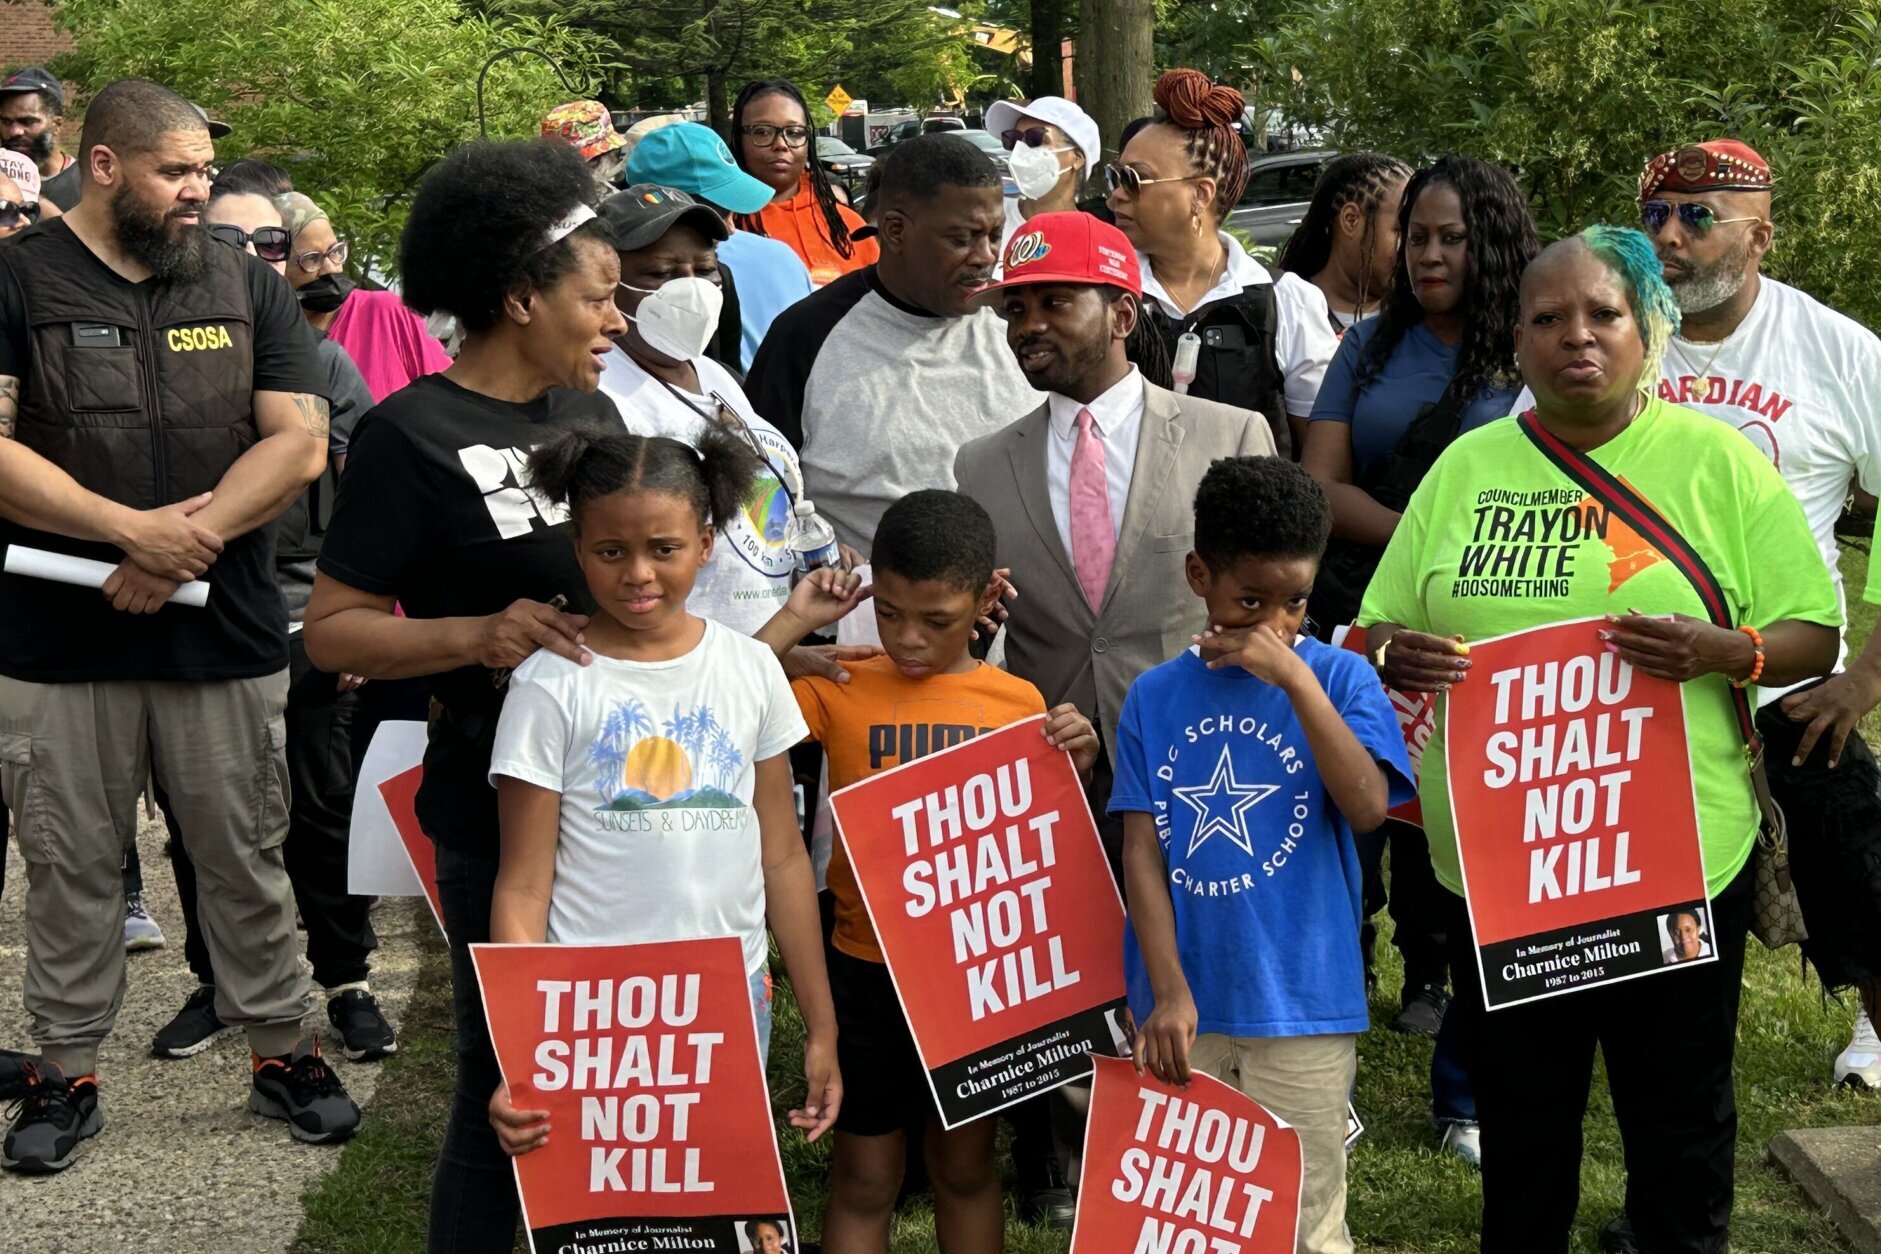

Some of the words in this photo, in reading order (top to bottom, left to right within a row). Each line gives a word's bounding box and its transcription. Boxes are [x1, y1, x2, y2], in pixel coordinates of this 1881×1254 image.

[168, 325, 233, 352] CSOSA
[1477, 488, 1583, 507] COUNCILMEMBER
[1472, 505, 1610, 543] TRAYON
[1458, 544, 1581, 578] WHITE
[1451, 578, 1569, 598] #DOSOMETHING
[1490, 651, 1633, 725] THOU
[869, 724, 1001, 769] PUM
[1185, 715, 1304, 775] SCHOLARS
[1483, 707, 1654, 789] SHALT
[593, 811, 652, 832] SUNSETS
[662, 811, 673, 831] &
[891, 757, 1032, 857] THOU
[1523, 770, 1632, 843] NOT
[902, 810, 1060, 918] SHALT
[1154, 801, 1172, 850] PUBL
[1171, 868, 1255, 897] CHARTER
[1262, 791, 1309, 877] SCHOOL
[1528, 831, 1641, 904] KILL
[950, 876, 1051, 964] NOT
[1516, 948, 1527, 958] In
[1527, 942, 1564, 956] Memory
[1564, 938, 1575, 948] of
[1576, 929, 1621, 946] Journalist
[966, 935, 1081, 1022] KILL
[1502, 954, 1580, 982] Charnice
[1583, 941, 1641, 965] Milton
[1545, 974, 1568, 988] 1987
[1569, 973, 1580, 983] to
[1580, 966, 1605, 981] 2015
[536, 973, 701, 1033] THOU
[532, 1032, 724, 1091] SHALT
[956, 1061, 1034, 1099] Charnice
[1036, 1039, 1093, 1069] Milton
[968, 1066, 979, 1075] In
[979, 1053, 1014, 1070] Memory
[1016, 1045, 1026, 1056] of
[1027, 1030, 1070, 1052] Journalist
[1002, 1083, 1022, 1098] 1987
[1026, 1080, 1036, 1089] to
[1037, 1069, 1061, 1085] 2015
[581, 1092, 701, 1142] NOT
[1134, 1087, 1266, 1174] THOU
[589, 1146, 715, 1193] KILL
[1111, 1147, 1274, 1239] SHALT
[576, 1231, 587, 1239] In
[589, 1228, 629, 1238] Memory
[632, 1226, 641, 1234] of
[644, 1226, 692, 1234] Journalist
[653, 1236, 716, 1250] Milton
